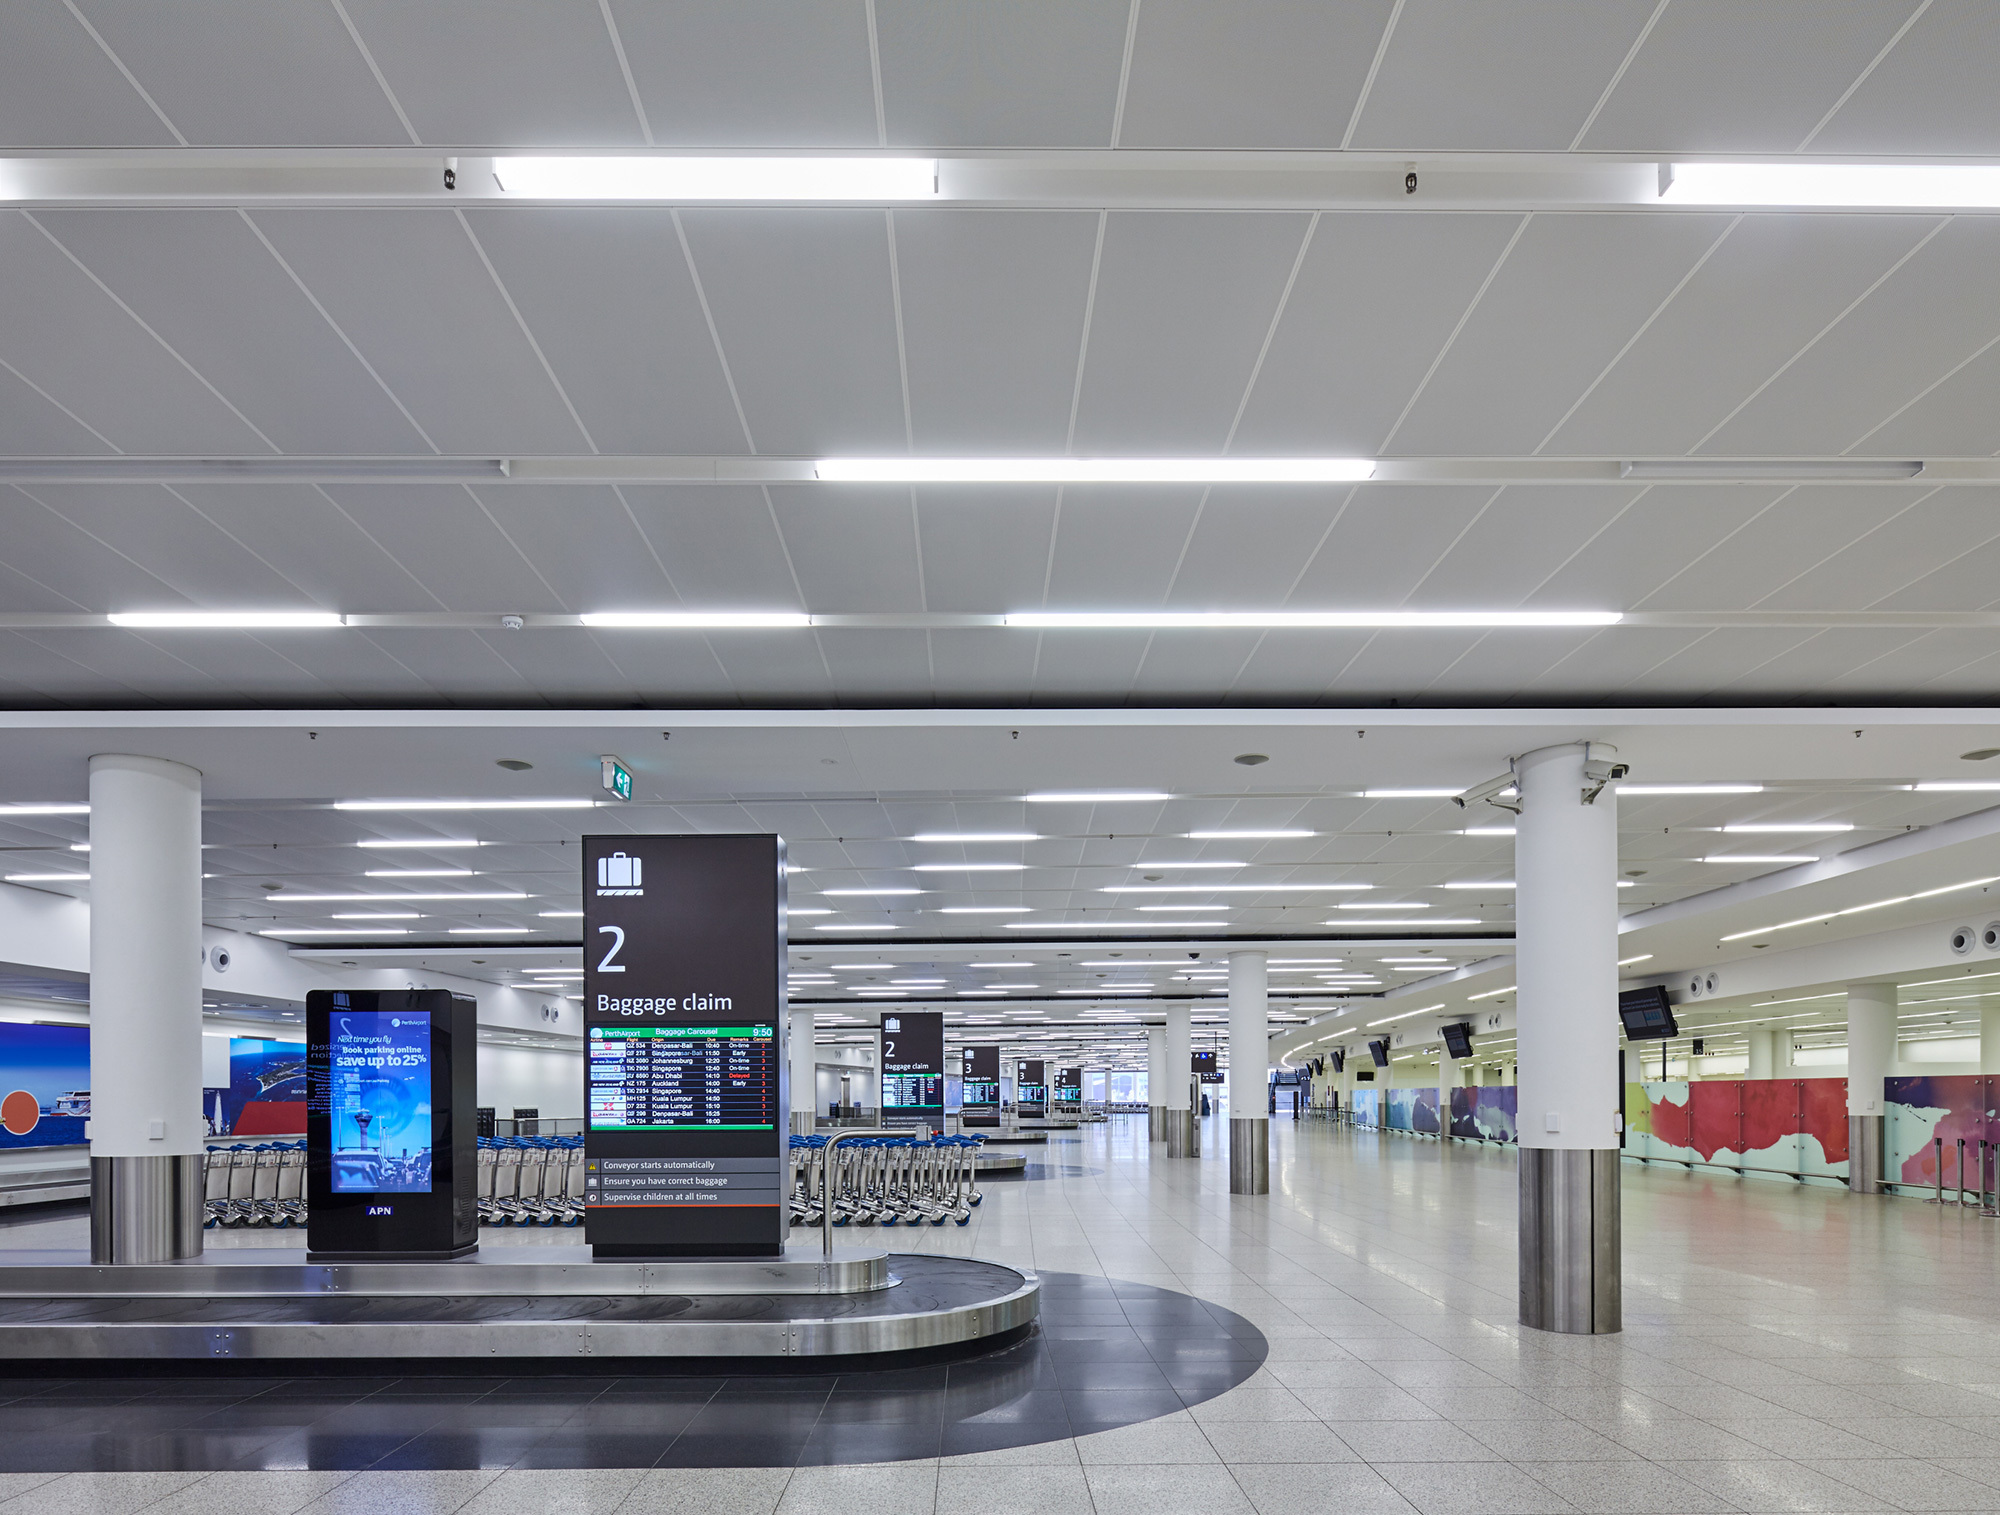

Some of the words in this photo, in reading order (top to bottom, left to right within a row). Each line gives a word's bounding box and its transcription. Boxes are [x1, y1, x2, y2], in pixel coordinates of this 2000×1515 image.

[597, 925, 626, 973] 2
[597, 994, 677, 1016] Baggage
[682, 992, 732, 1011] claim
[656, 1028, 686, 1036] Baggage
[752, 1028, 772, 1036] 9:50
[383, 1035, 392, 1044] fly
[364, 1046, 395, 1055] parking
[885, 1041, 895, 1058] 2
[336, 1056, 366, 1066] save
[368, 1056, 385, 1069] up
[386, 1055, 402, 1066] to
[403, 1054, 427, 1066] 25%
[885, 1063, 911, 1071] Baggage
[965, 1063, 972, 1074] 3
[604, 1161, 639, 1171] Conveyor
[663, 1161, 715, 1170] automatically
[648, 1177, 667, 1185] have
[695, 1177, 728, 1186] baggage
[604, 1193, 641, 1202] Supervise
[642, 1192, 674, 1201] children
[684, 1192, 694, 1201] all
